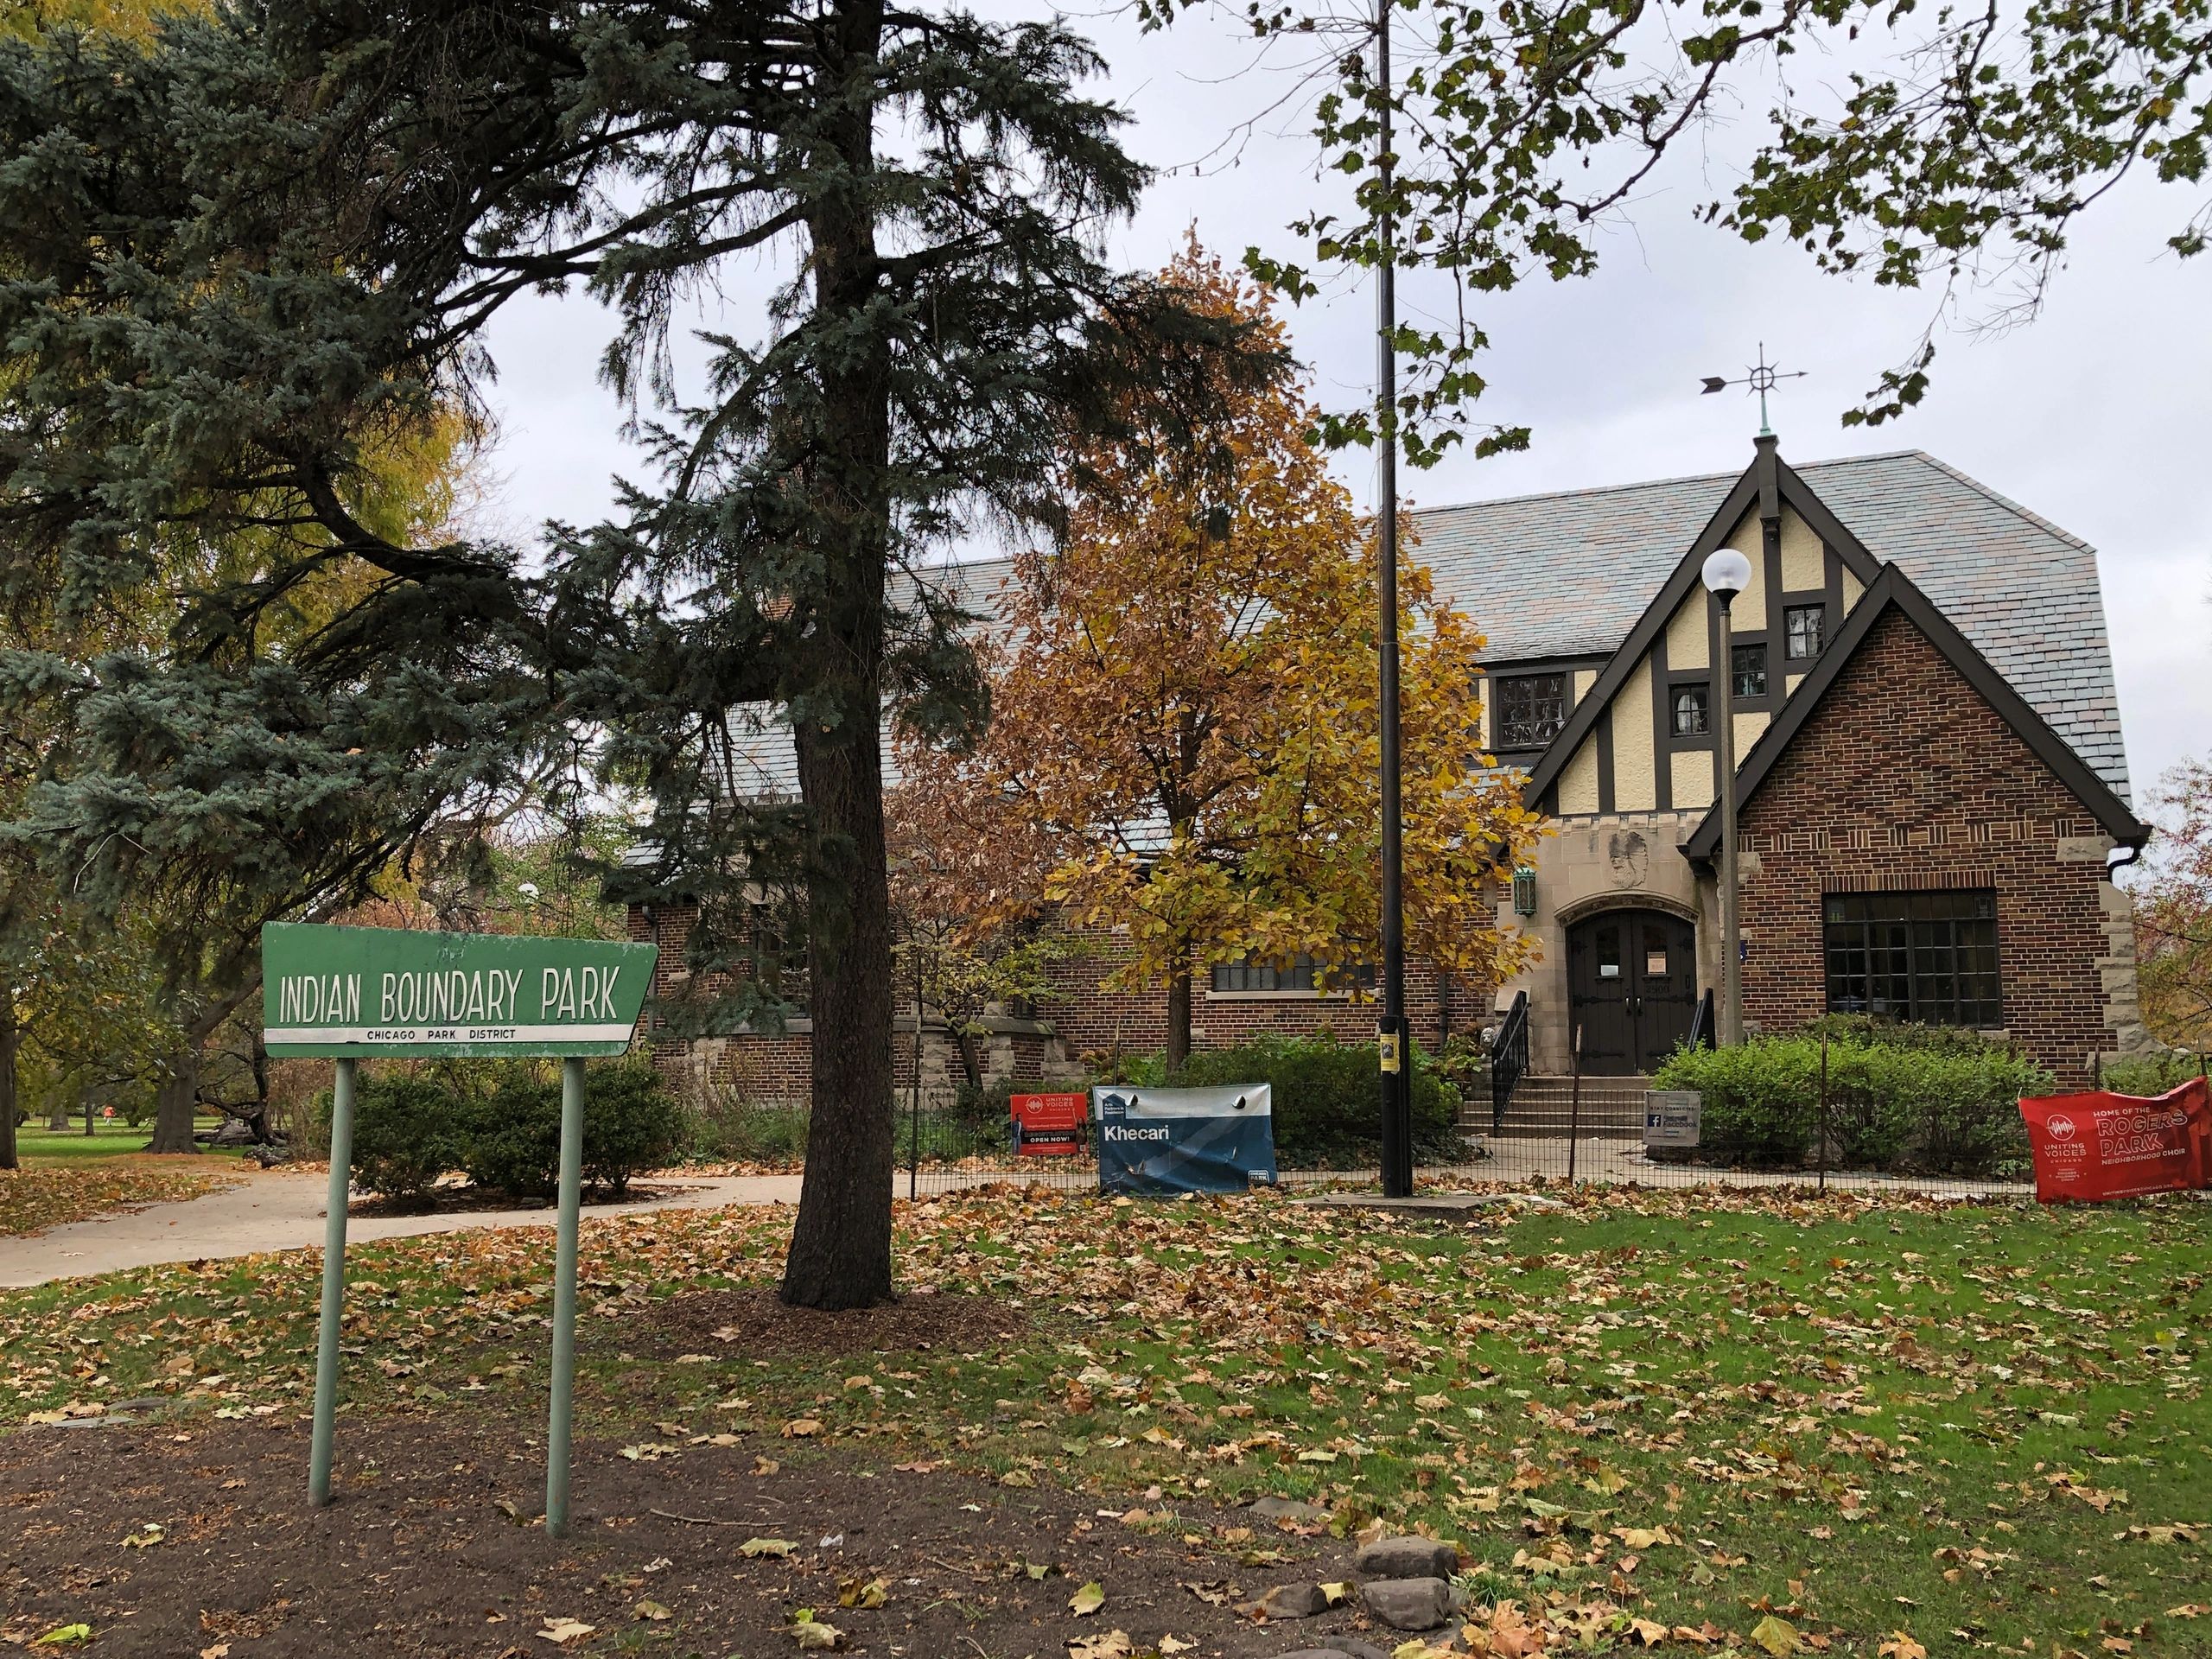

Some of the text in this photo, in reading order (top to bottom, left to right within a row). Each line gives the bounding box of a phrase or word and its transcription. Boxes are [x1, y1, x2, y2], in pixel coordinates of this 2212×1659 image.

[279, 965, 620, 1023] INDIAN BOUNDARY PARK
[367, 1029, 517, 1040] CHICAGO PARK DISTRICT
[1104, 1124, 1169, 1141] Khecari
[2096, 1109, 2188, 1136] ROGERS
[2100, 1133, 2164, 1157] PARK
[2101, 1148, 2186, 1166] NEIGHBORHOOD CHOIR
